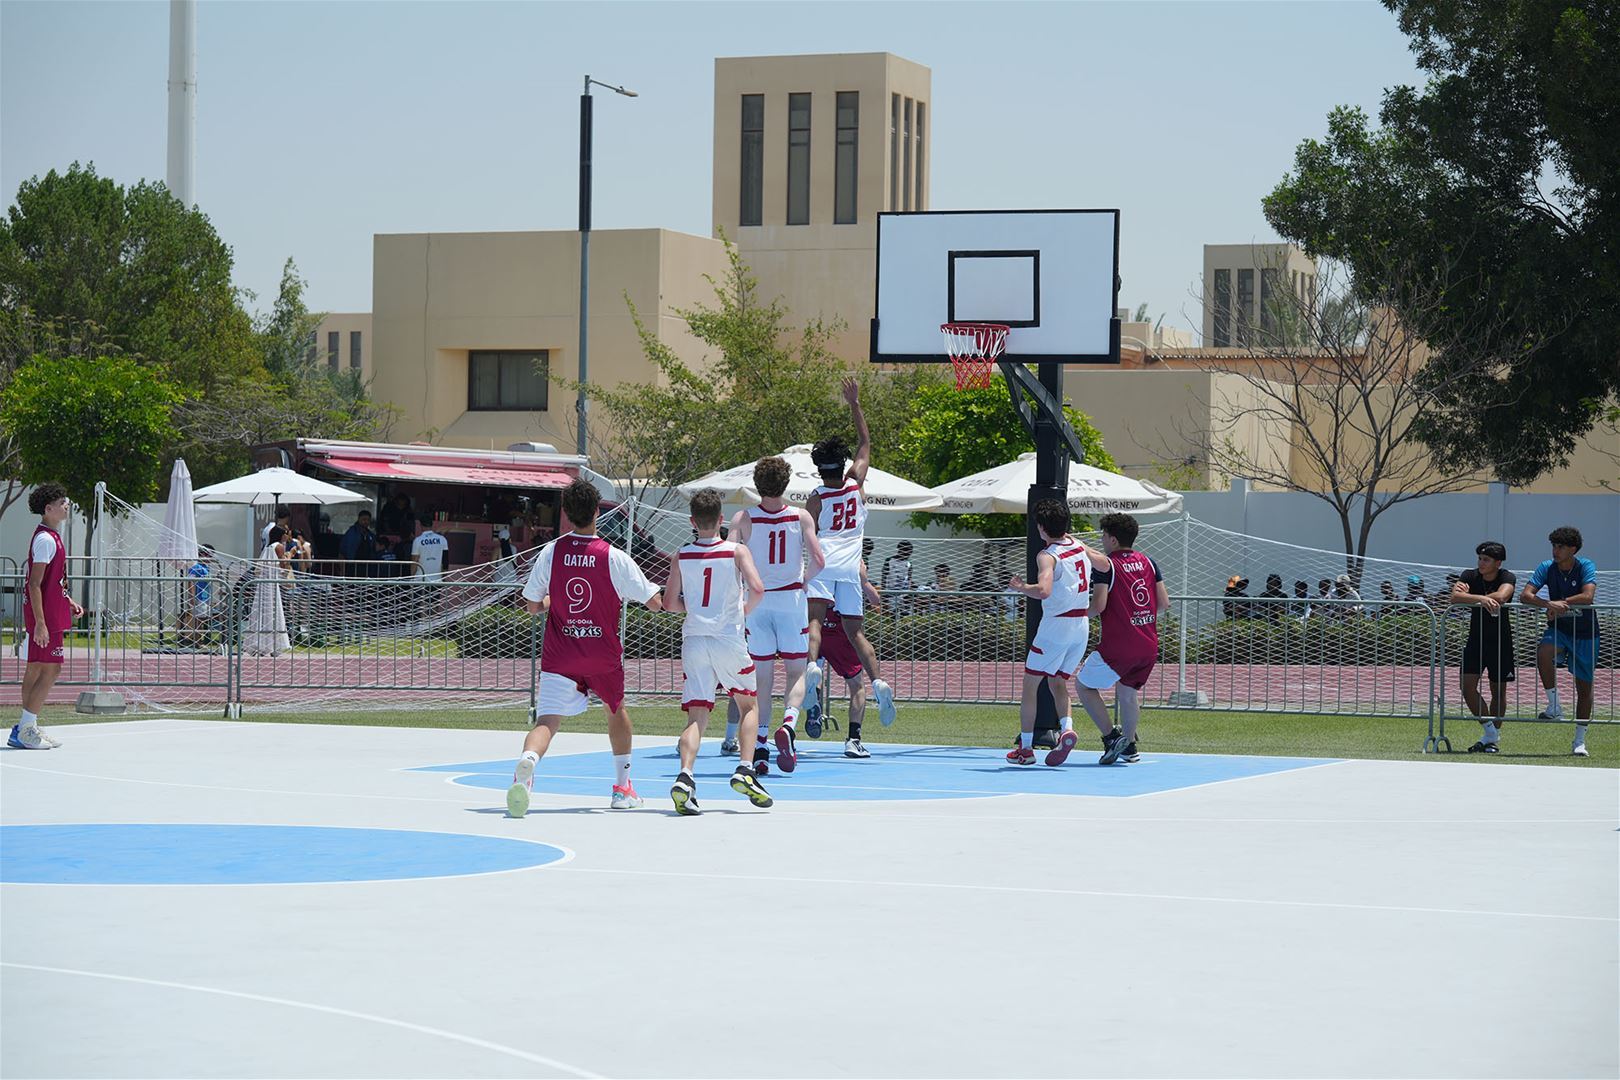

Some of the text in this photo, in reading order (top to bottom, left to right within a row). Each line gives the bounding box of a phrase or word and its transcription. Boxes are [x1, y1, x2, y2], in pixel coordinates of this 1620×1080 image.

[829, 497, 857, 531] 22
[875, 497, 896, 505] NEW
[1068, 500, 1139, 509] SOMETHING NEW
[420, 538, 441, 546] COACH
[768, 529, 786, 565] 11
[563, 553, 596, 568] QATAR
[701, 567, 712, 608] 1
[1075, 559, 1088, 593] 3
[565, 576, 592, 614] 9
[1130, 578, 1150, 607] 6
[562, 625, 602, 639] ORYXES
